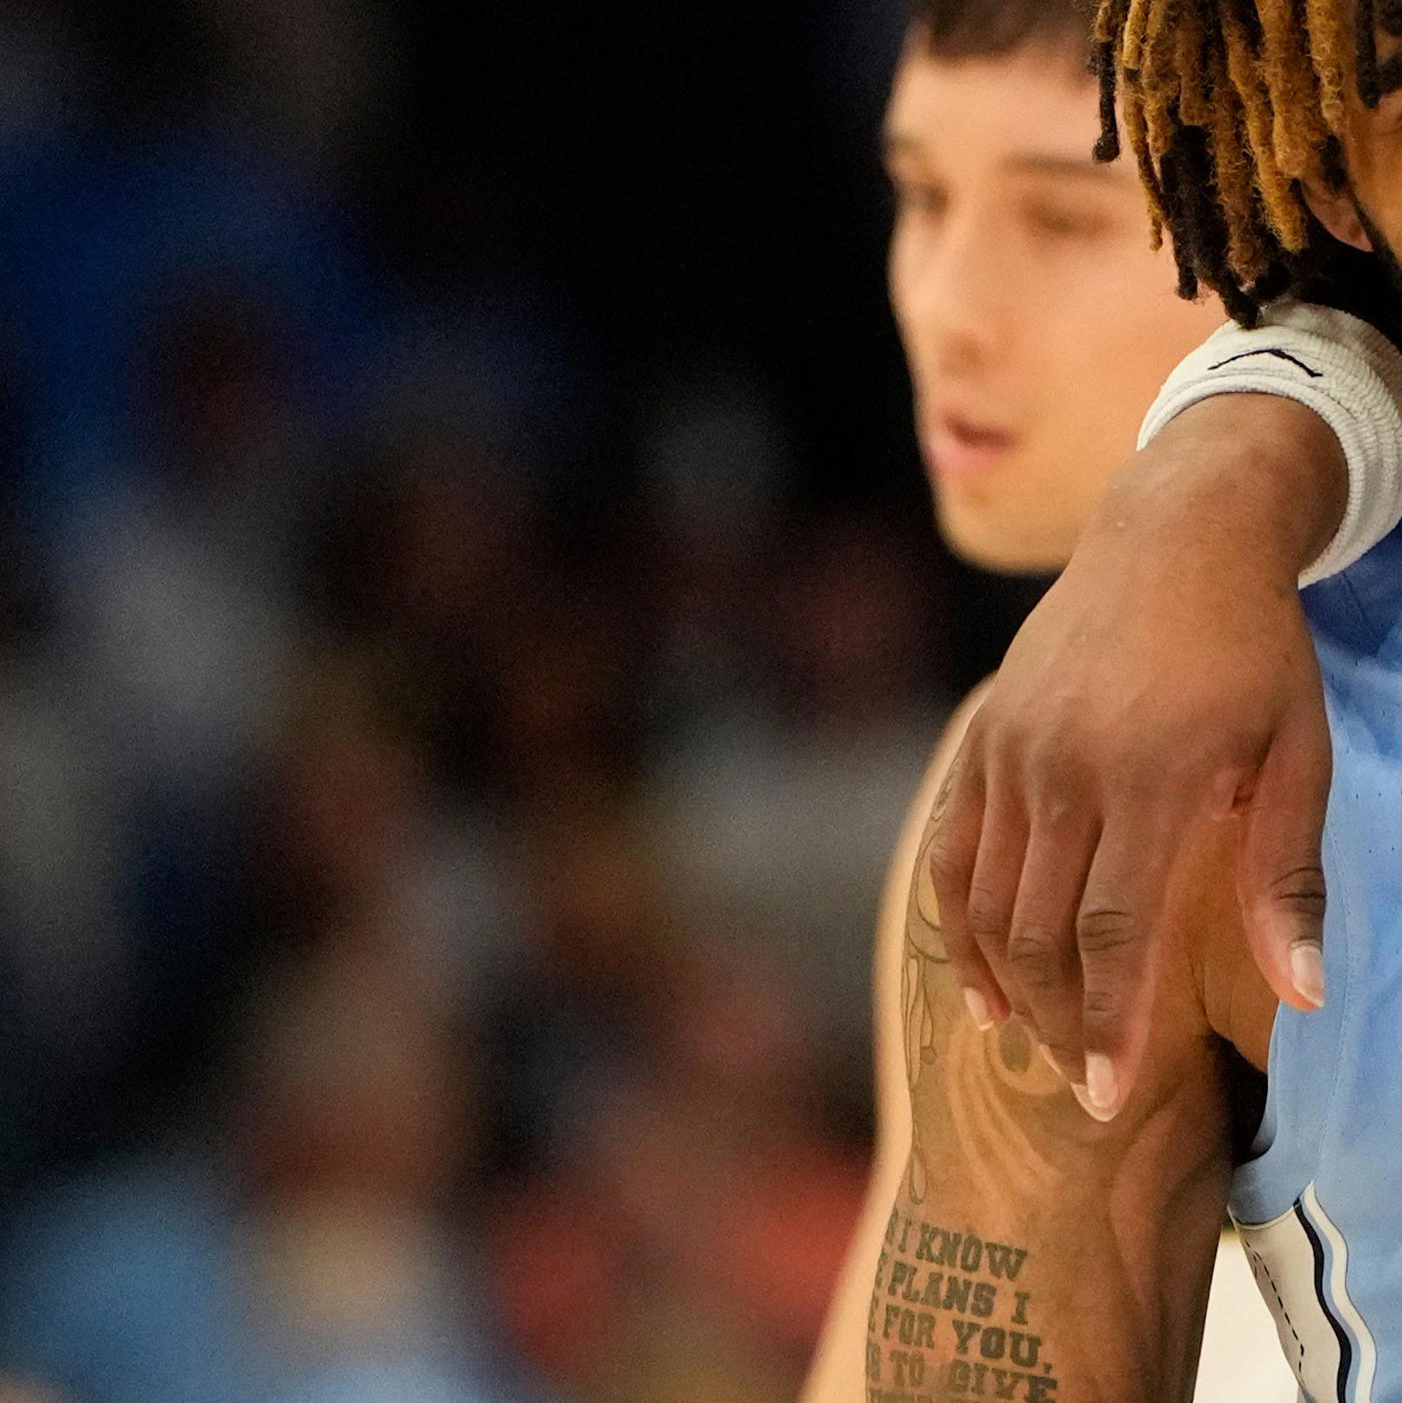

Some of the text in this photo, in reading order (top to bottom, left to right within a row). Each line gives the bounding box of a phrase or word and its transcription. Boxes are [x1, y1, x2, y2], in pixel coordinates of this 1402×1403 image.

[915, 1221, 1029, 1282] KNOW
[887, 1260, 999, 1318] PLANS
[1010, 1291, 1031, 1326] I
[882, 1303, 937, 1350] FOR
[889, 1349, 926, 1388] TO
[949, 1359, 1058, 1403] GIVE
